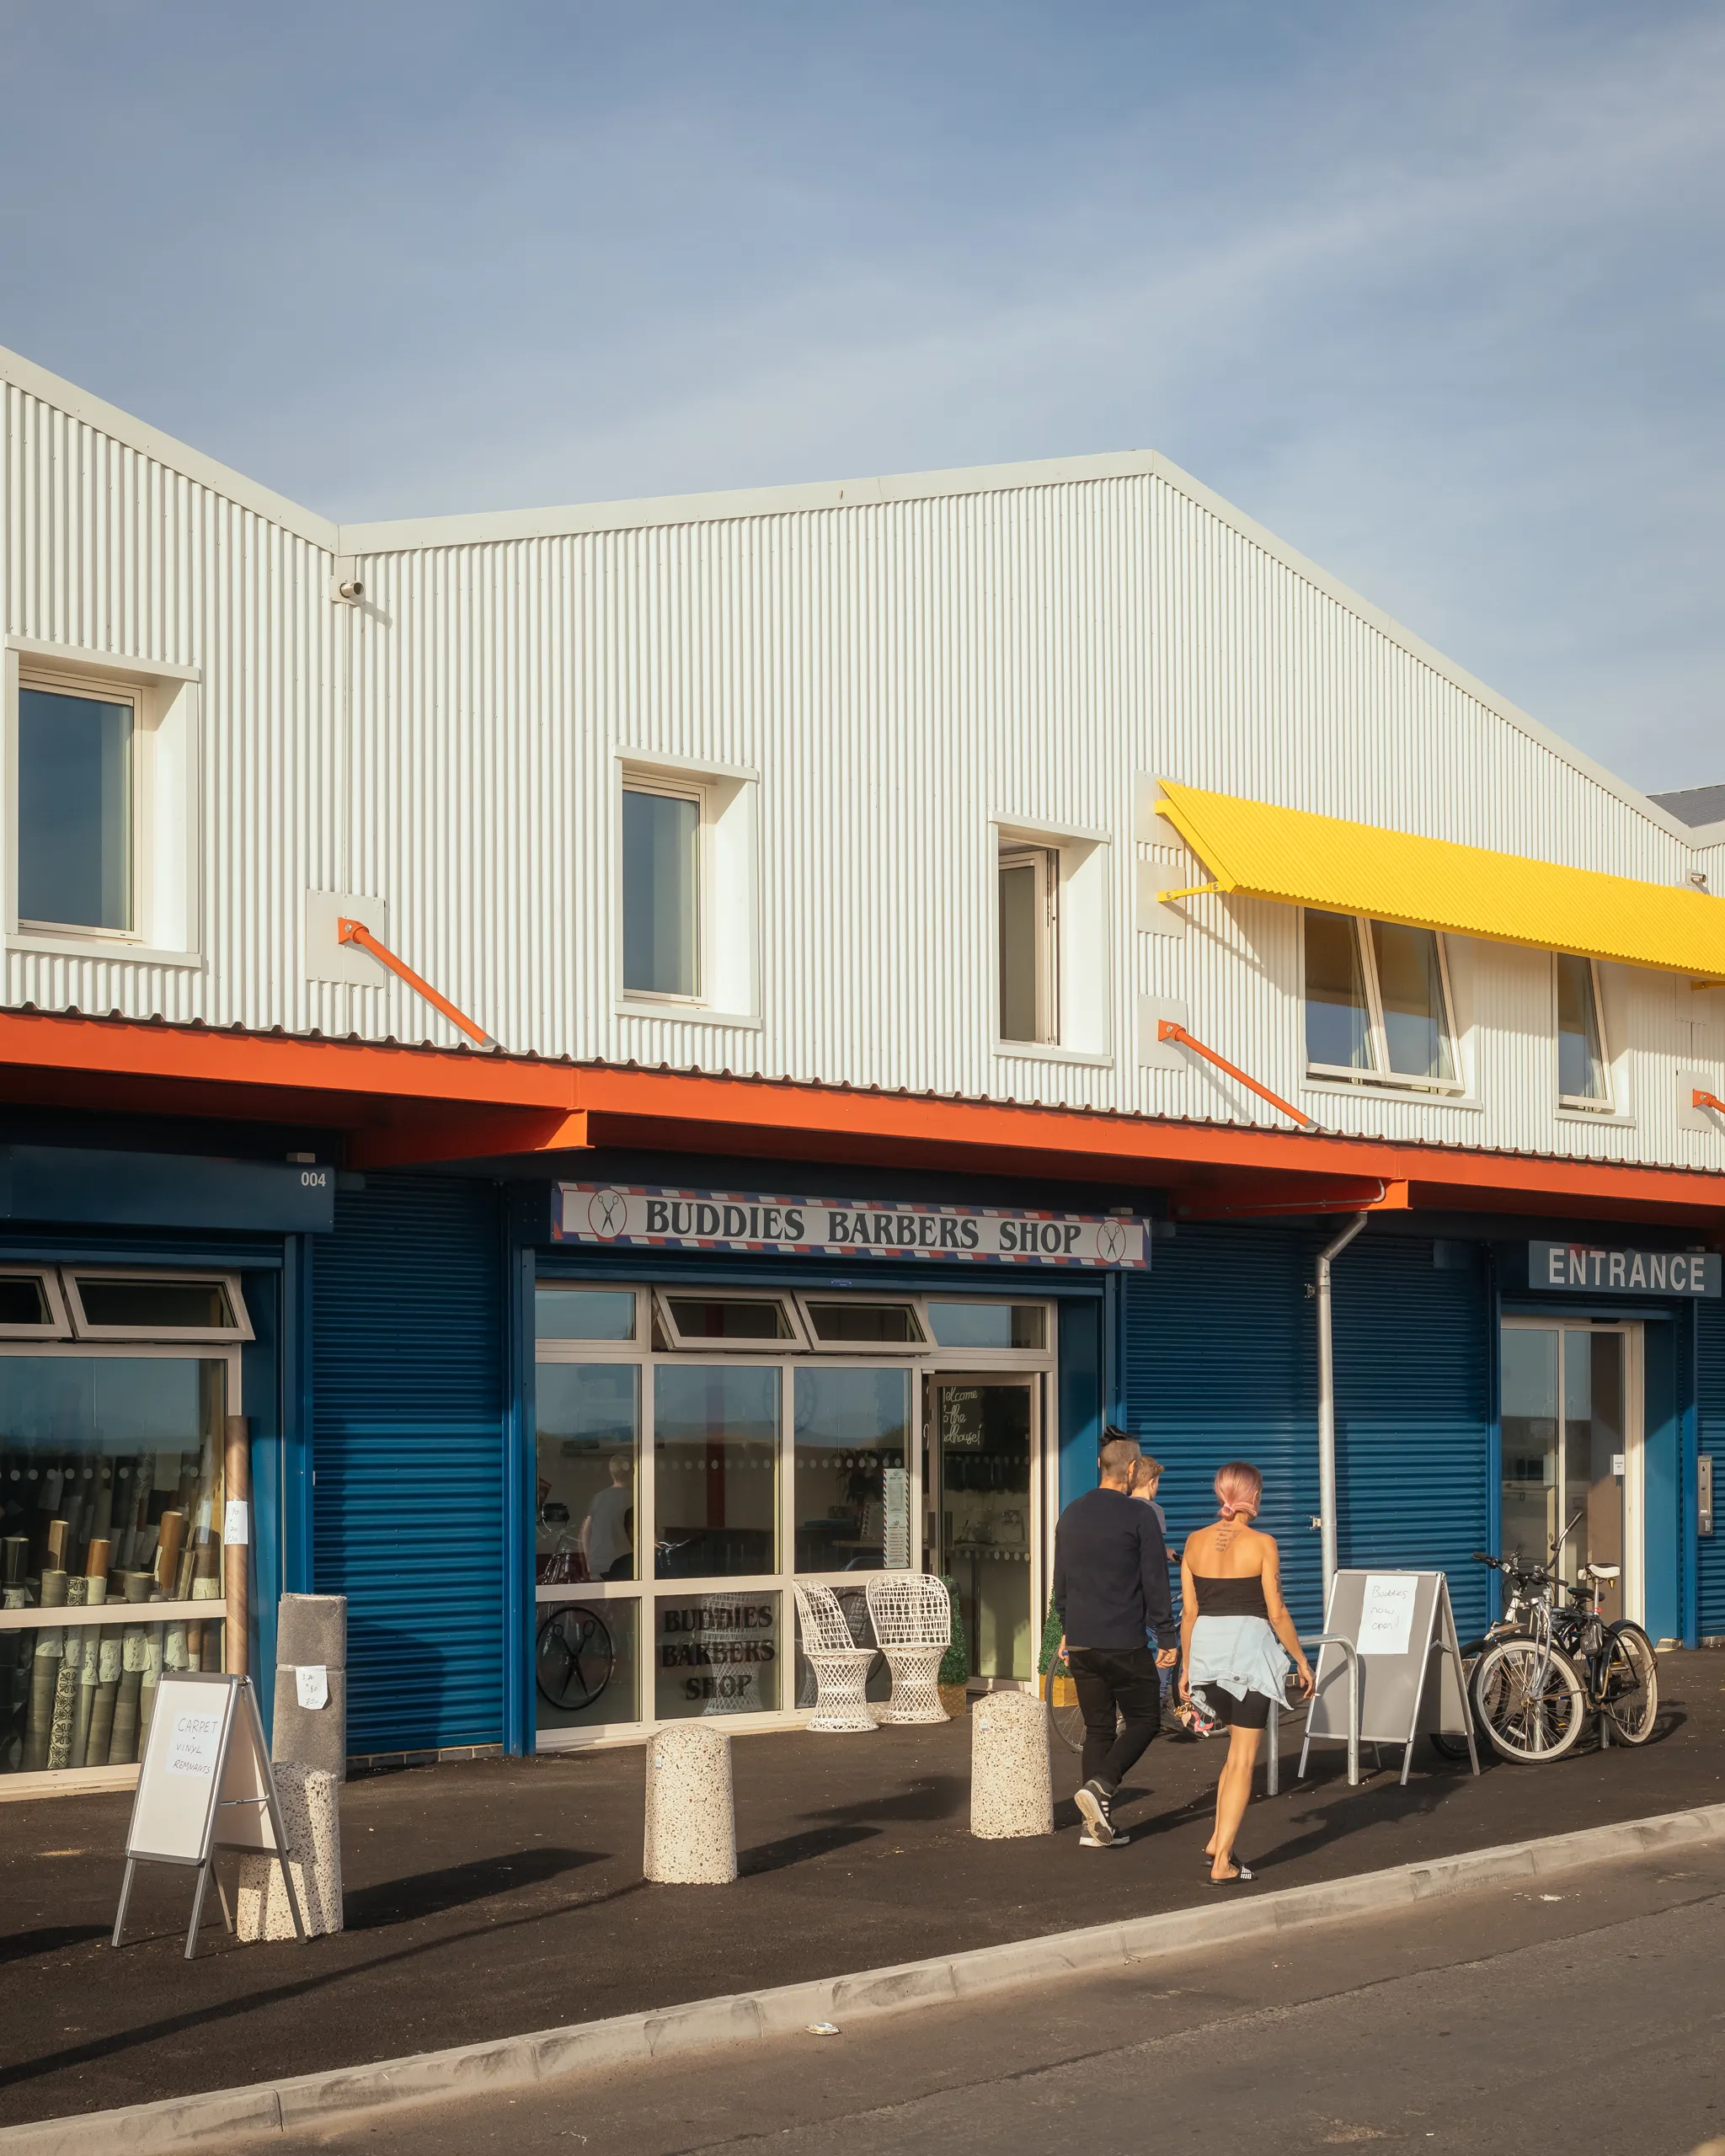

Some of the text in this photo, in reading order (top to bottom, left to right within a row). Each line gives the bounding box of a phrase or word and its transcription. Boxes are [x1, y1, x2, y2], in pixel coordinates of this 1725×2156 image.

[301, 1171, 326, 1187] 004
[645, 1200, 1081, 1253] BUDDIES BARBERS SHOP
[1549, 1248, 1705, 1291] ENTRANCE
[1372, 1585, 1409, 1598] Buddies
[664, 1606, 772, 1632] BUDDIES
[662, 1640, 776, 1667] BARBERS
[685, 1674, 752, 1700] SHOP
[178, 1718, 218, 1733] CARPET
[176, 1743, 202, 1754] VINYL
[173, 1759, 211, 1774] REMNANTS
